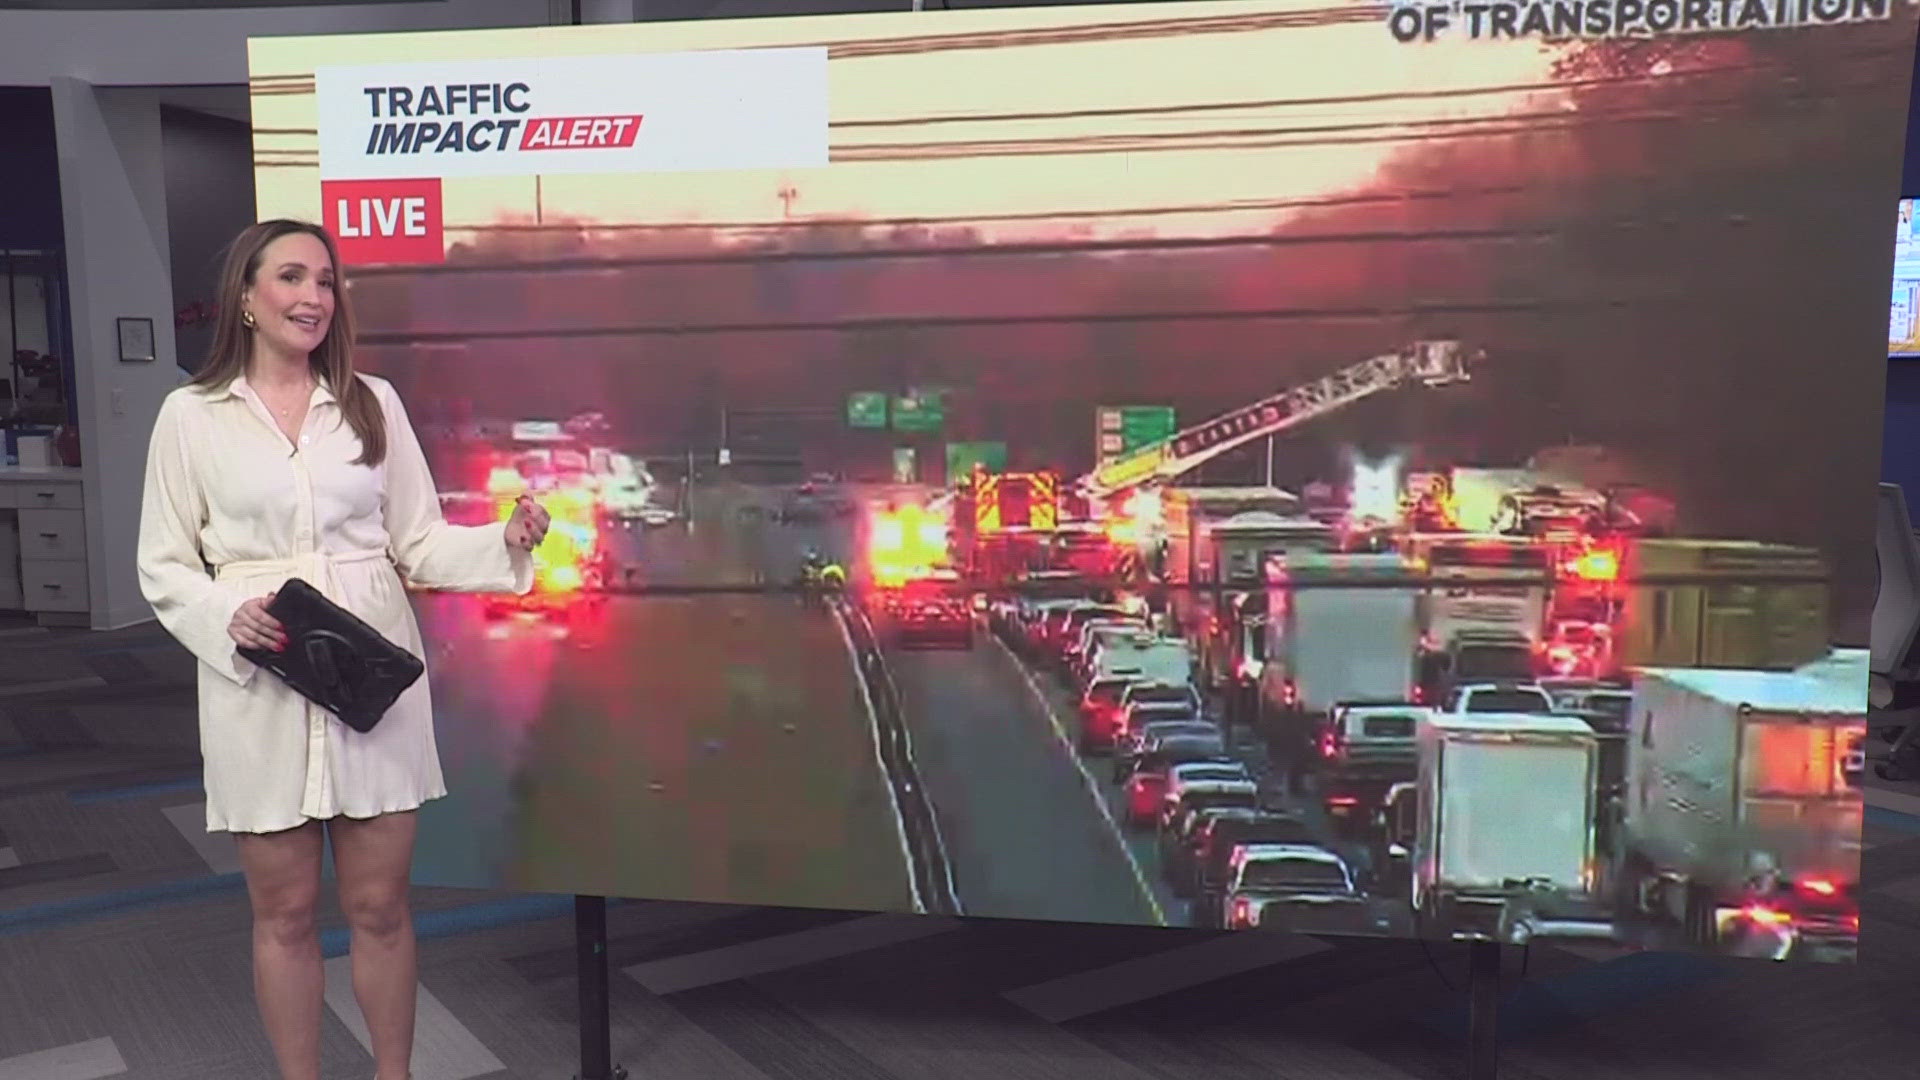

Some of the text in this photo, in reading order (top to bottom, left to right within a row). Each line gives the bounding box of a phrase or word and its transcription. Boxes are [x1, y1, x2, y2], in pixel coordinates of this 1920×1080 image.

[1390, 0, 1886, 42] OF TRANSPORTATION
[364, 82, 531, 118] TRAFFIC
[366, 118, 633, 155] IMPACT ALERT
[337, 197, 427, 238] LIVE
